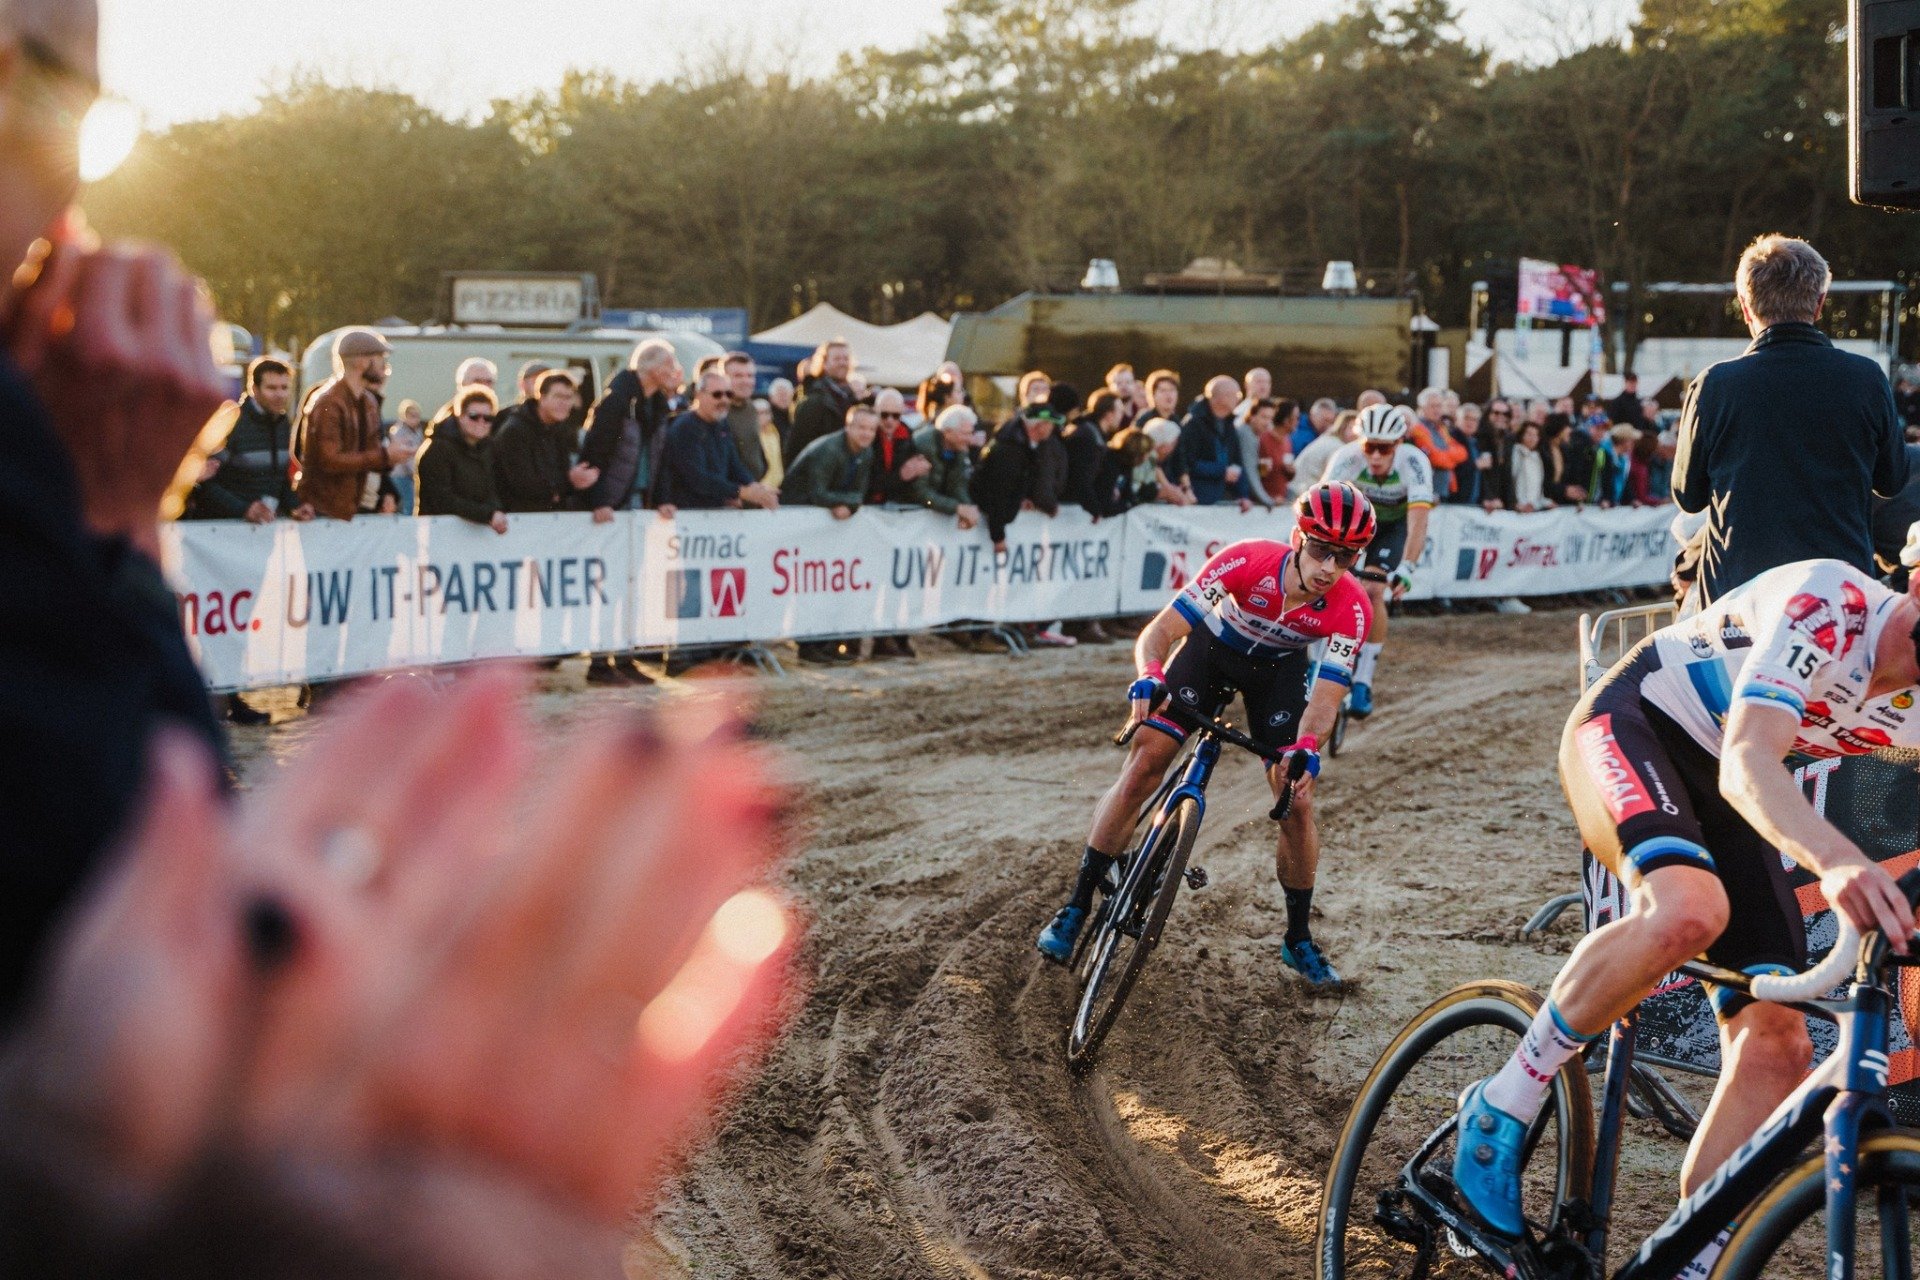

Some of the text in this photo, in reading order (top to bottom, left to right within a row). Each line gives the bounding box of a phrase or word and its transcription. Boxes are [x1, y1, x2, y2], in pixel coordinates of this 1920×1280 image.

[460, 289, 575, 312] PIZZERIA
[666, 526, 748, 560] simac
[772, 540, 1110, 595] Simac. UW IT-PARTNER
[1209, 556, 1247, 580] Baloise
[178, 557, 609, 637] mac. UW IT-PARTNER
[1247, 618, 1302, 645] Baloi
[1330, 640, 1354, 658] 35
[1785, 644, 1819, 680] 15
[1836, 729, 1879, 750] Pauw
[1582, 725, 1642, 813] BINGOAL
